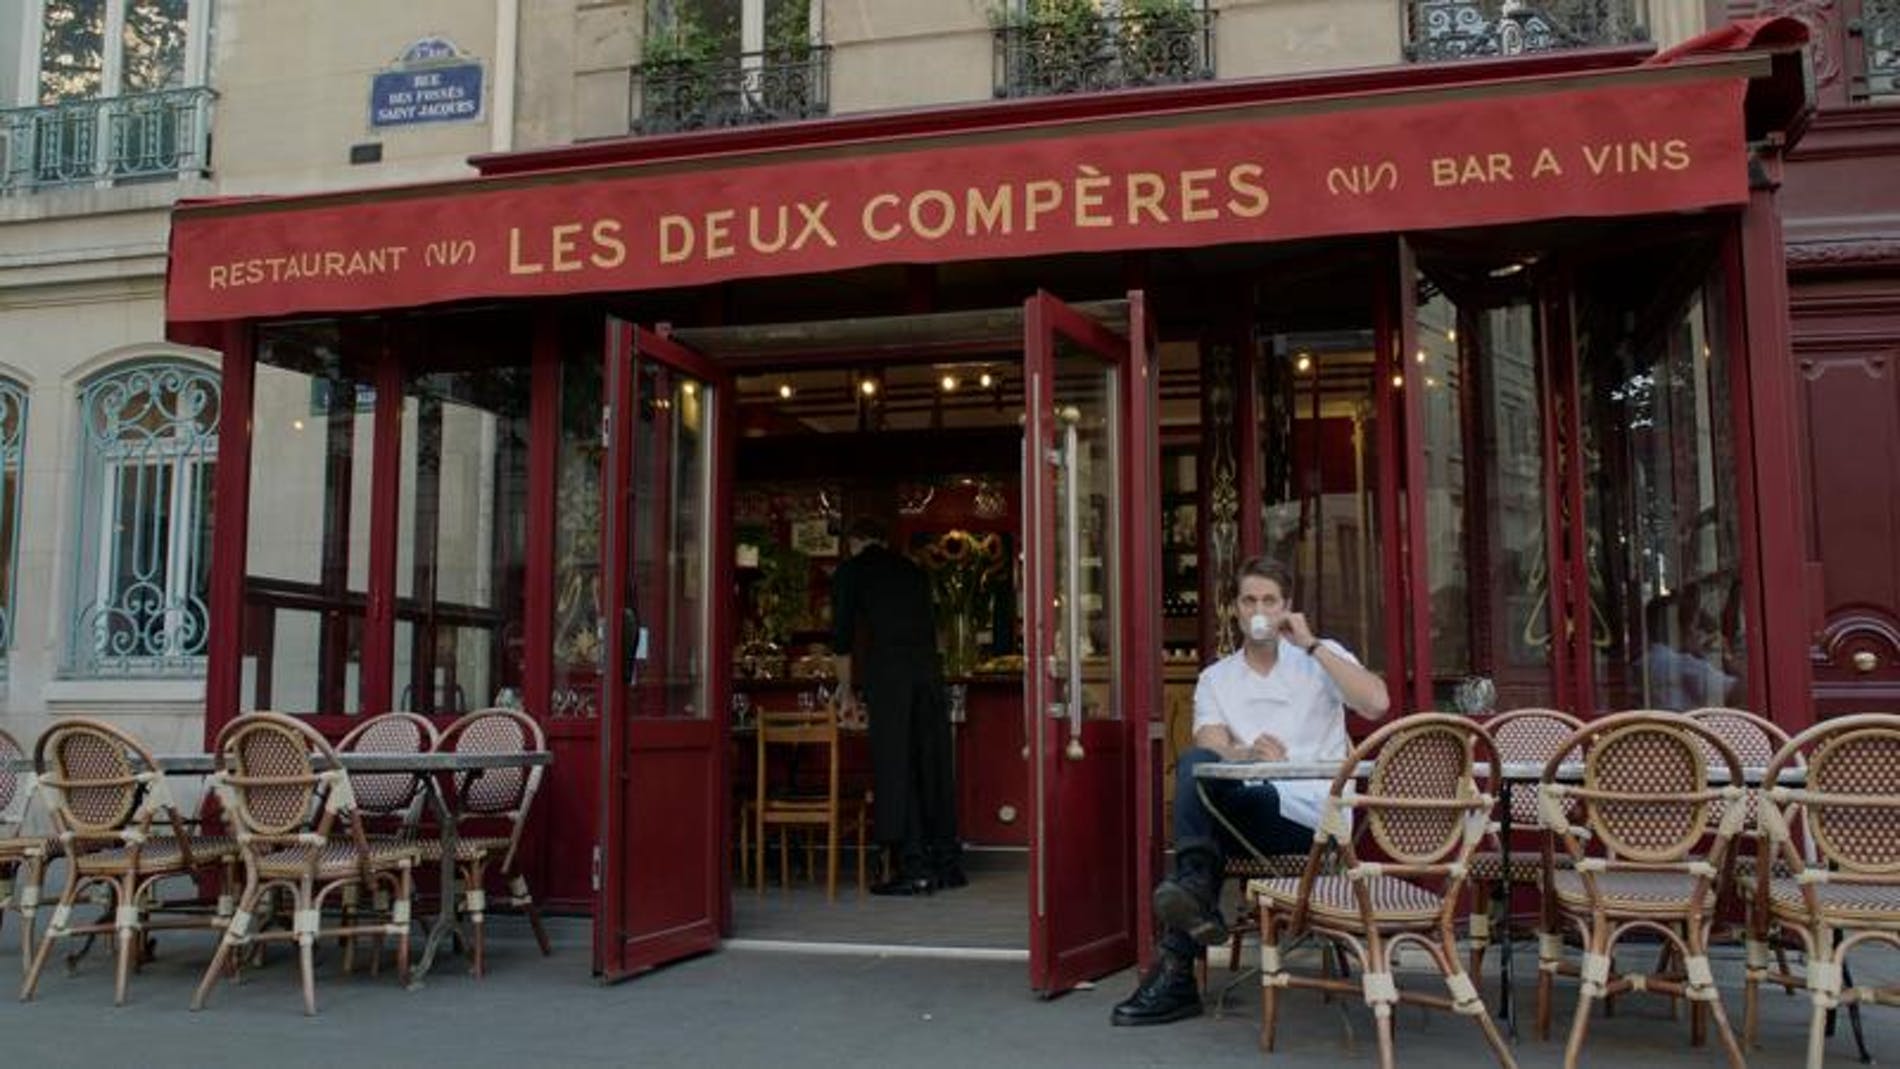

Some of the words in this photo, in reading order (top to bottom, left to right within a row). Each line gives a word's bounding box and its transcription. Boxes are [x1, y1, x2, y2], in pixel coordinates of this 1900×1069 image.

[414, 73, 441, 88] RUE
[388, 90, 413, 105] DES
[377, 105, 416, 121] SAINT
[418, 99, 476, 116] JACQUES
[208, 245, 407, 290] RESTAURANT
[508, 219, 627, 275] LES
[658, 201, 838, 264] DEUX
[861, 164, 1271, 242] COMPÈRES
[1431, 153, 1514, 188] BAR
[1531, 148, 1562, 179] A
[1583, 138, 1692, 175] VINS
